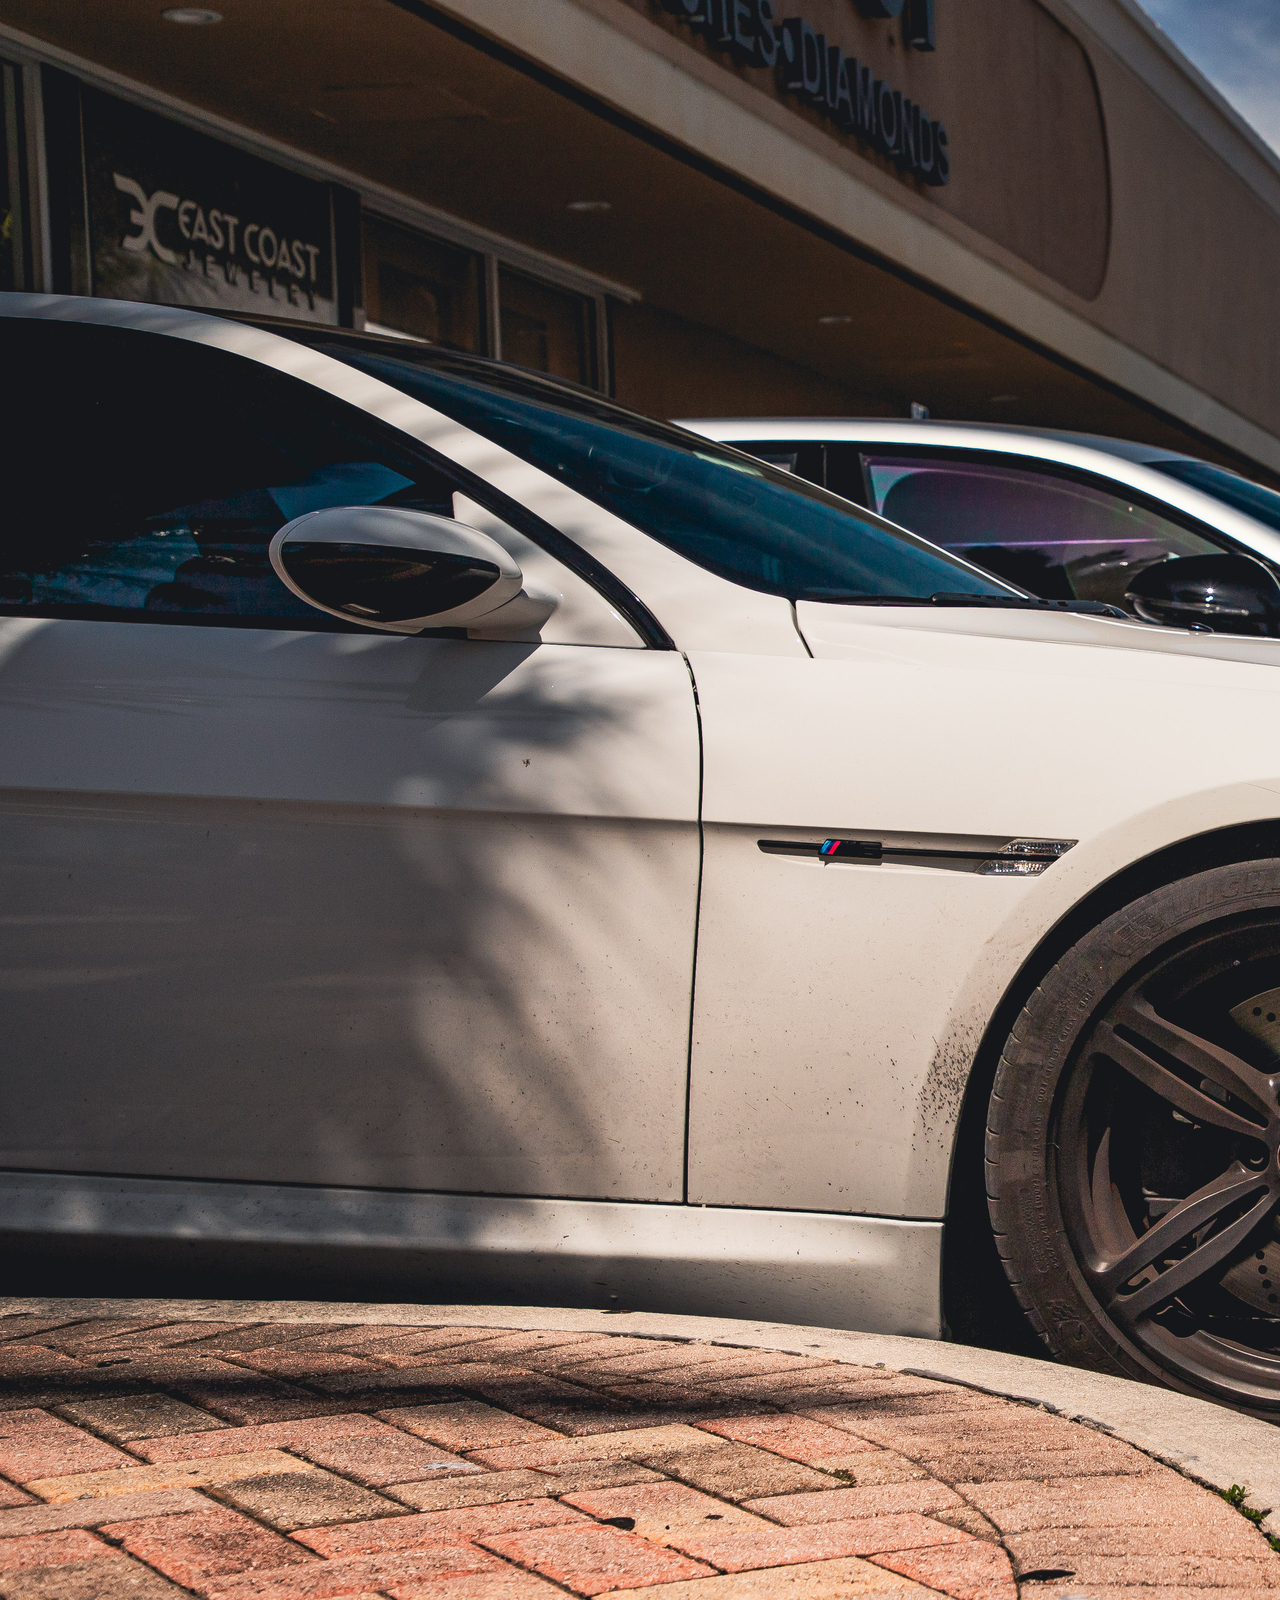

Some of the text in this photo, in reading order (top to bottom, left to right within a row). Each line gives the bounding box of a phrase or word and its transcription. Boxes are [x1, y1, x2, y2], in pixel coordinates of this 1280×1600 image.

[800, 20, 950, 184] DIAMONDS
[178, 200, 320, 284] EAST COAST
